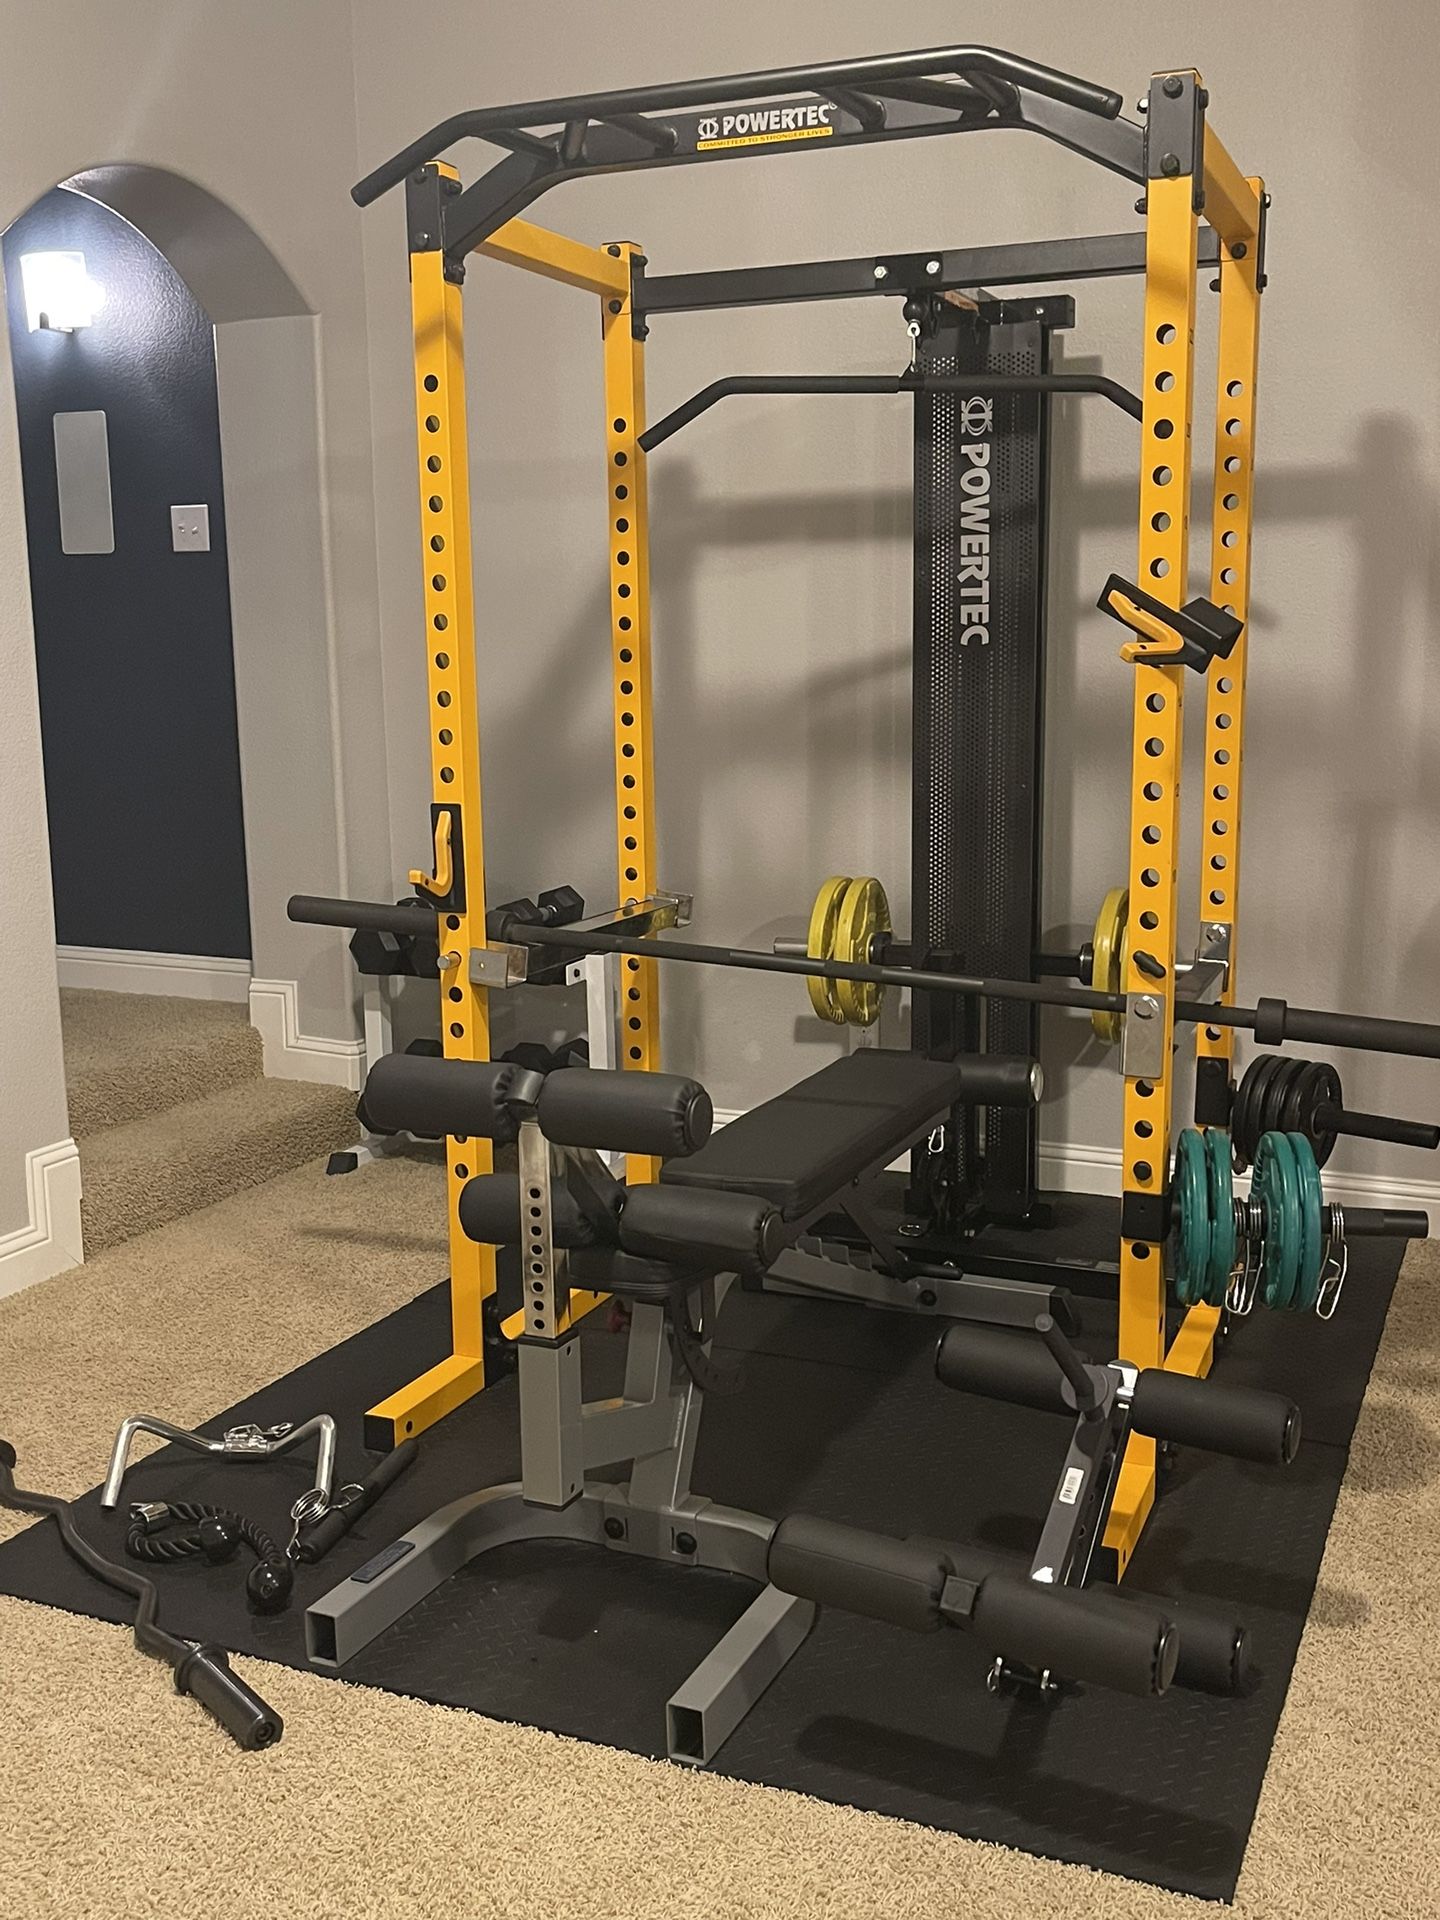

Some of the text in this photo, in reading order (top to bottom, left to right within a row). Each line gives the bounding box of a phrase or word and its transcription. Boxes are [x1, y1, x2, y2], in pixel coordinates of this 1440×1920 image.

[722, 104, 829, 136] POWERTEC
[698, 138, 746, 149] COMMITTED
[760, 131, 805, 142] STRONGER
[807, 128, 830, 137] LIVES
[956, 442, 991, 646] POWERTEC
